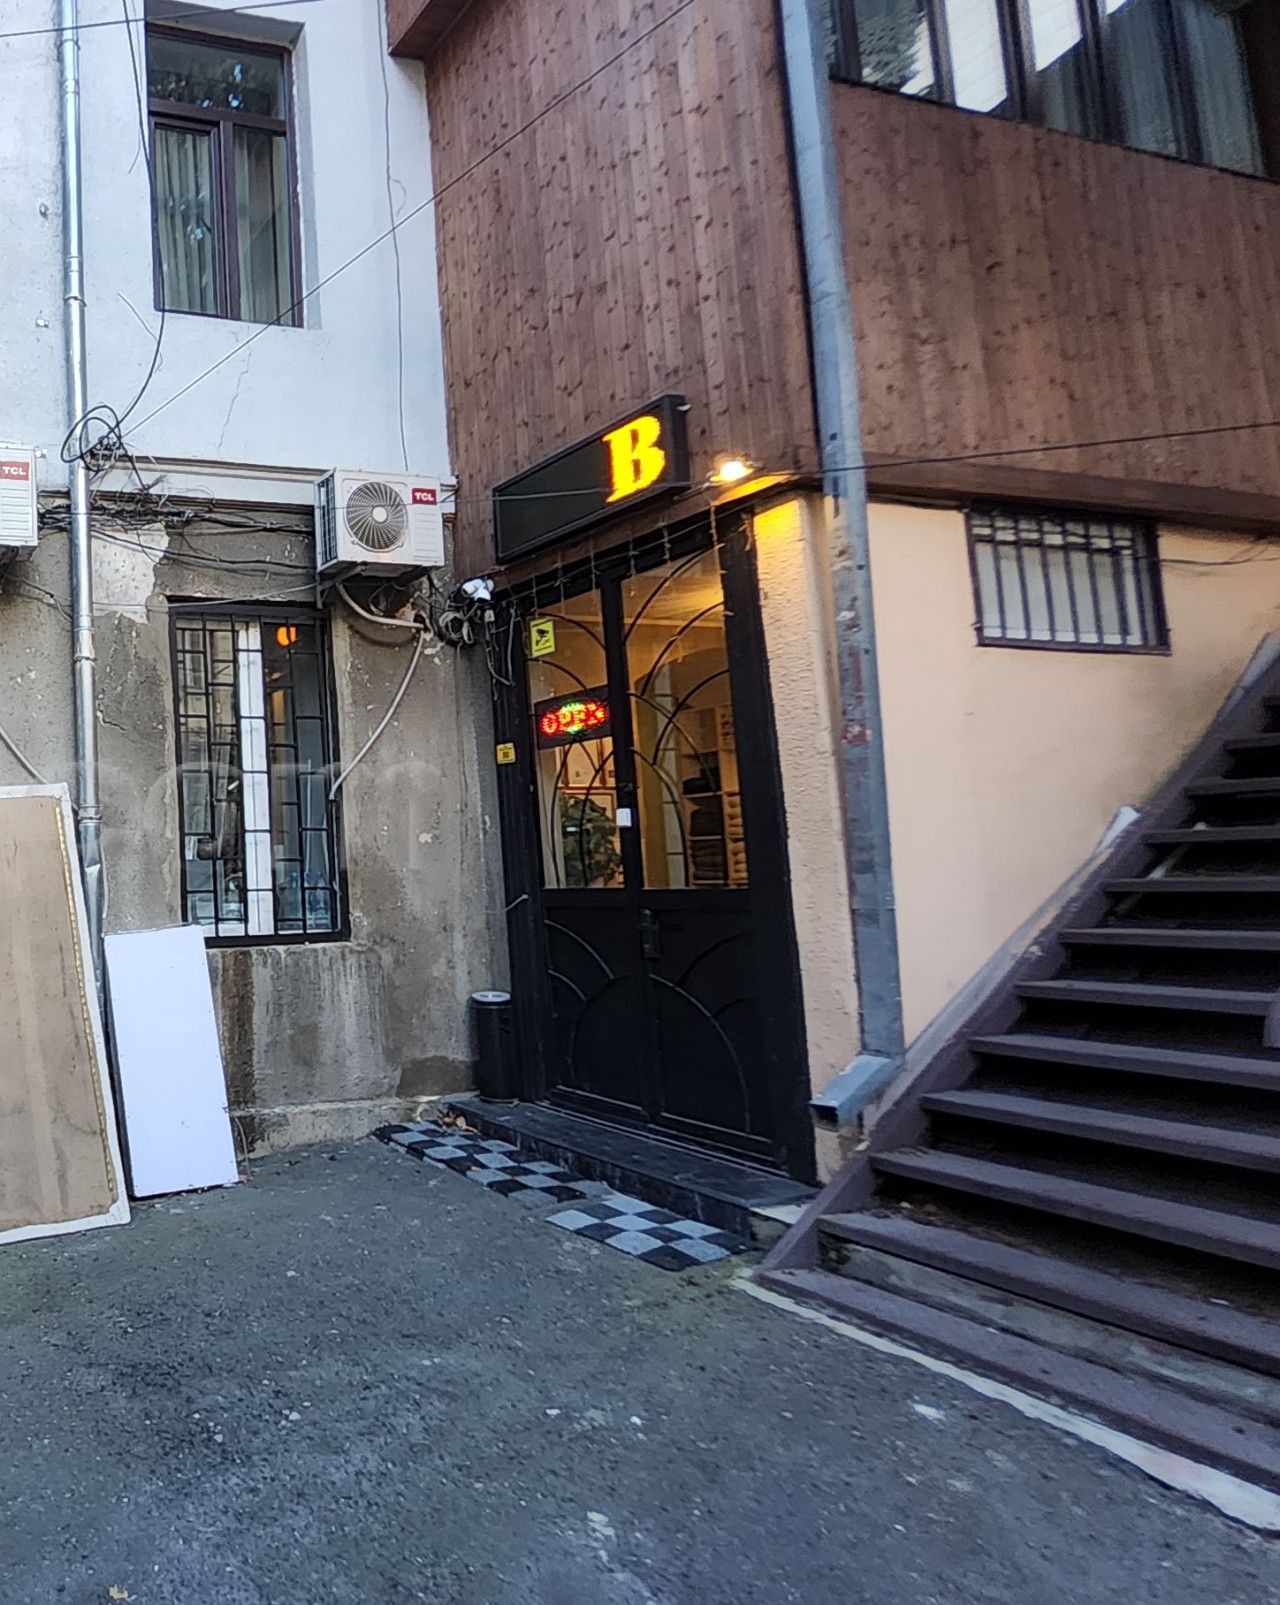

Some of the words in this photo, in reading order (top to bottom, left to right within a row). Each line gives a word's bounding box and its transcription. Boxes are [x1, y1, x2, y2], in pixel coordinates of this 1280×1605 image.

[603, 414, 666, 503] B
[2, 466, 26, 475] TCL
[414, 492, 434, 502] TCL
